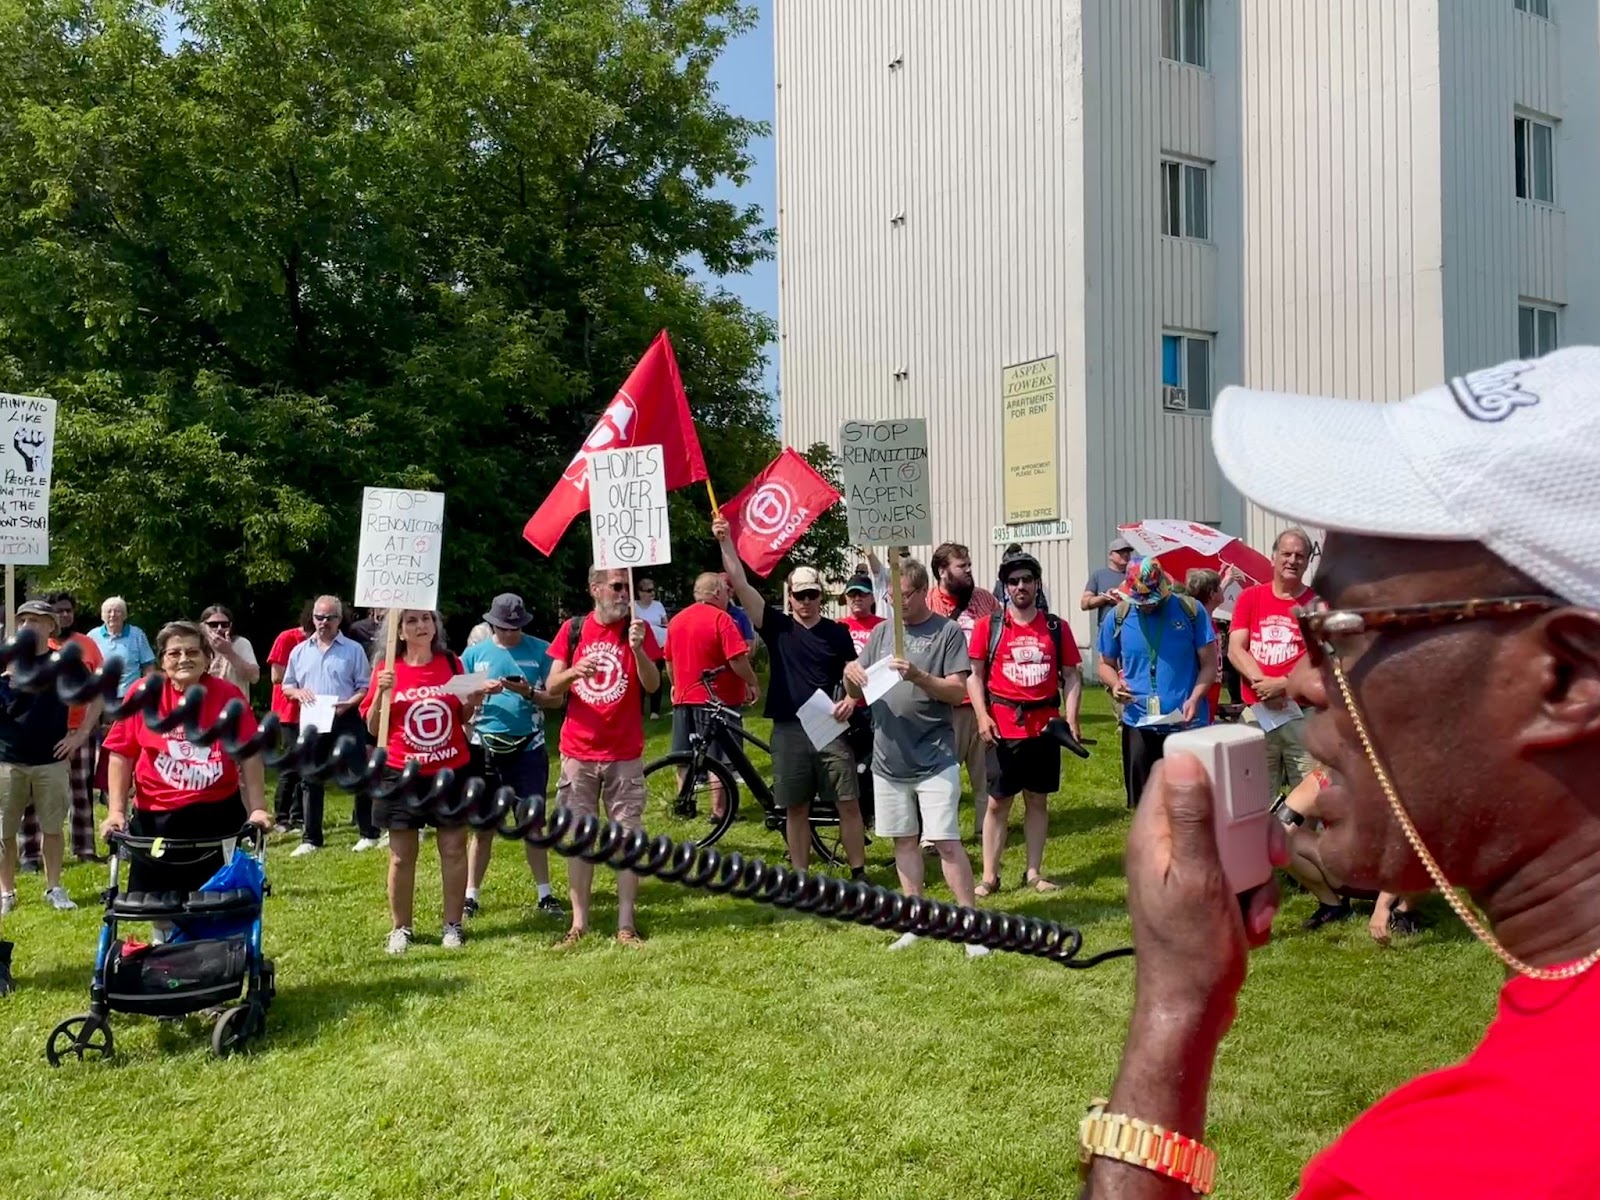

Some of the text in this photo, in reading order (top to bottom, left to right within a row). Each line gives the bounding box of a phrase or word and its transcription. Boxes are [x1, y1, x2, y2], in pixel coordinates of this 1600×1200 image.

[1011, 361, 1047, 379] ASPEN
[1008, 374, 1052, 393] TOWERS
[29, 401, 47, 412] NO
[1006, 392, 1054, 409] APARTMENTS
[8, 411, 42, 423] LIKE
[1011, 404, 1047, 418] FOR RENT
[844, 422, 908, 442] STOP
[593, 447, 658, 481] HOMES
[5, 469, 46, 486] PEOPLE
[869, 467, 893, 483] AT
[16, 488, 40, 498] THE
[367, 490, 427, 510] STOP
[609, 480, 651, 508] OVER
[851, 484, 913, 505] ASPEN
[10, 501, 35, 511] THE
[852, 504, 927, 524] TOWERS
[596, 507, 665, 539] PROFIT
[1014, 522, 1052, 538] RICHMOND
[858, 525, 916, 541] ACORN
[384, 536, 409, 551] AT
[363, 553, 422, 568] ASPEN
[366, 570, 435, 587] TOWERS
[363, 588, 415, 603] ACORN
[585, 641, 619, 655] ACORN
[602, 679, 629, 704] UNION
[404, 747, 458, 764] OTTAWA
